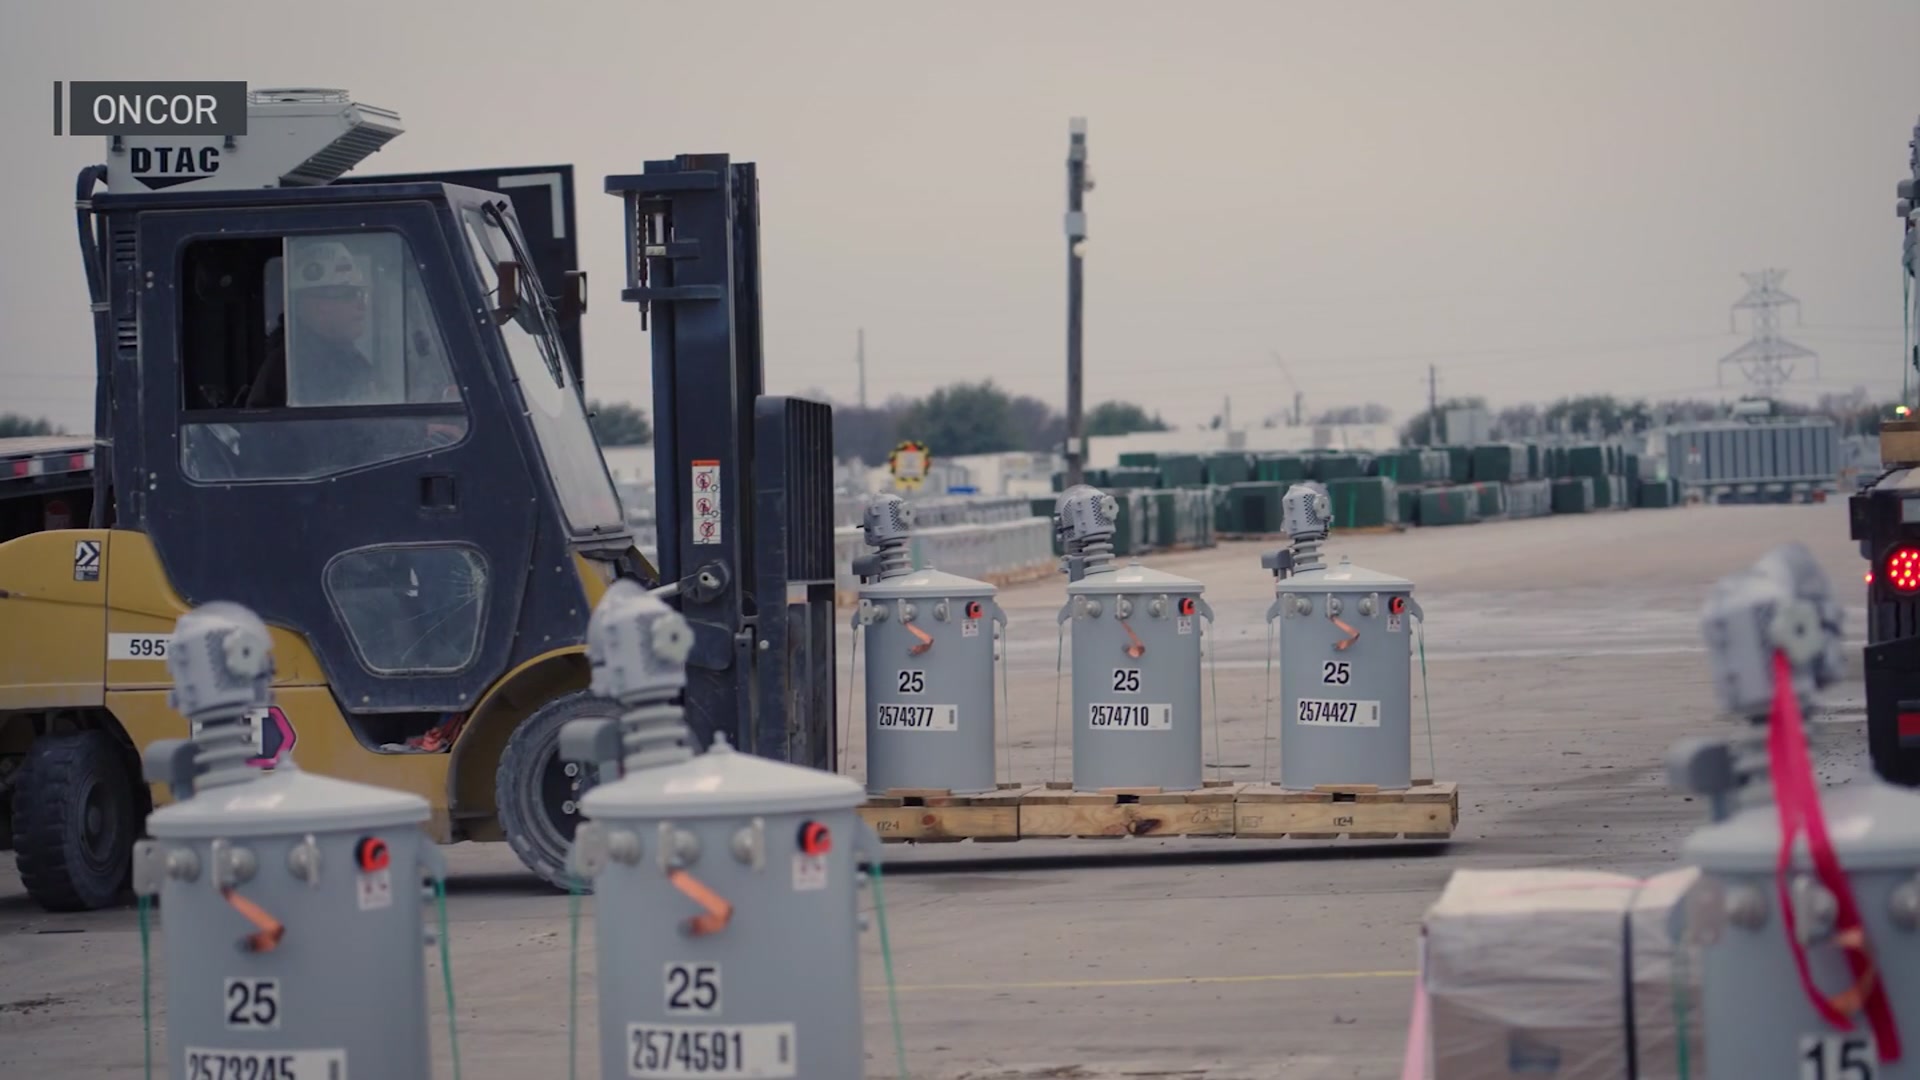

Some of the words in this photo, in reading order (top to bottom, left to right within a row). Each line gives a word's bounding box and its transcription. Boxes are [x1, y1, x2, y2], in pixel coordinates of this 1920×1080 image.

[130, 146, 220, 174] DTAC
[130, 639, 170, 656] 595
[899, 670, 924, 693] 25
[1113, 669, 1140, 691] 25
[1323, 661, 1350, 684] 25
[879, 705, 934, 727] 2574377
[1091, 705, 1149, 727] 2574710
[1299, 700, 1357, 723] 2574427
[667, 966, 718, 1010] 25
[227, 981, 277, 1025] 25
[632, 1028, 743, 1072] 2574591
[1805, 1040, 1872, 1080] 15
